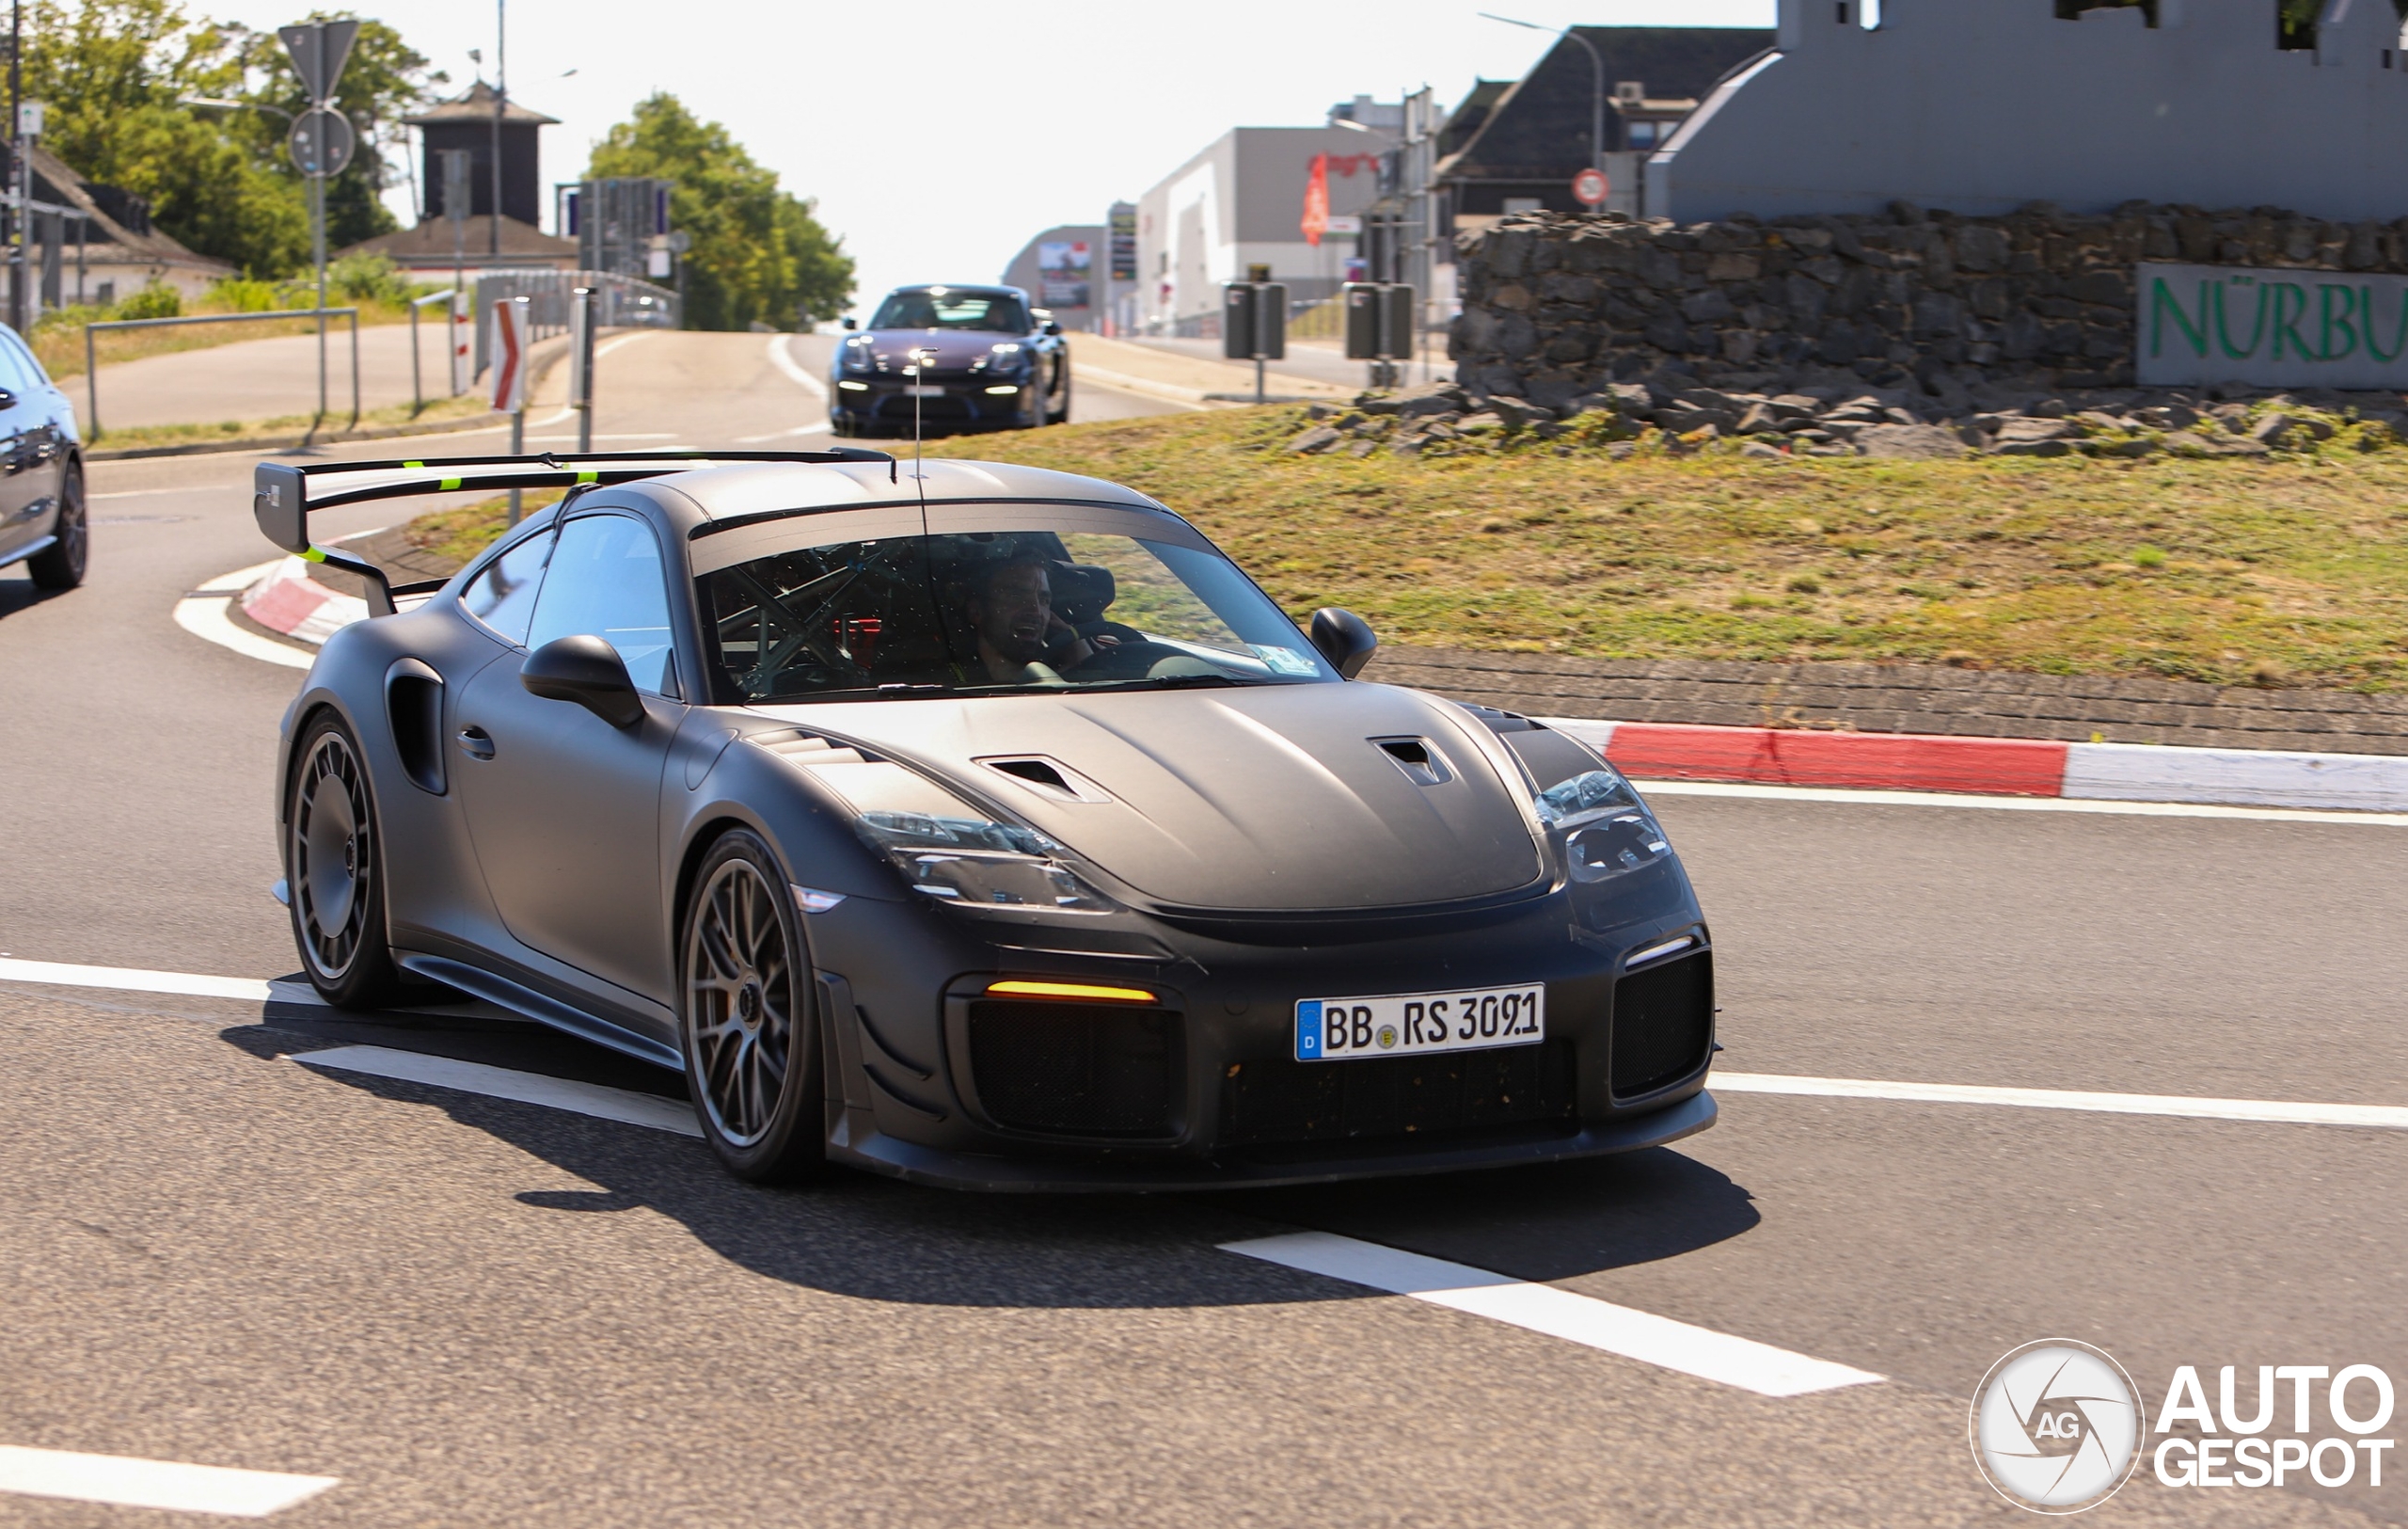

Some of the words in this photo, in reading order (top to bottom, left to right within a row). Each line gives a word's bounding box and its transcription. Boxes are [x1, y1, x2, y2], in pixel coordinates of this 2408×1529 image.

[2150, 275, 2408, 363] NÜRBU
[1304, 1036, 1315, 1049] D
[1325, 1006, 1373, 1050] BB
[1403, 1000, 1449, 1045] RS
[1458, 991, 1539, 1041] 3091
